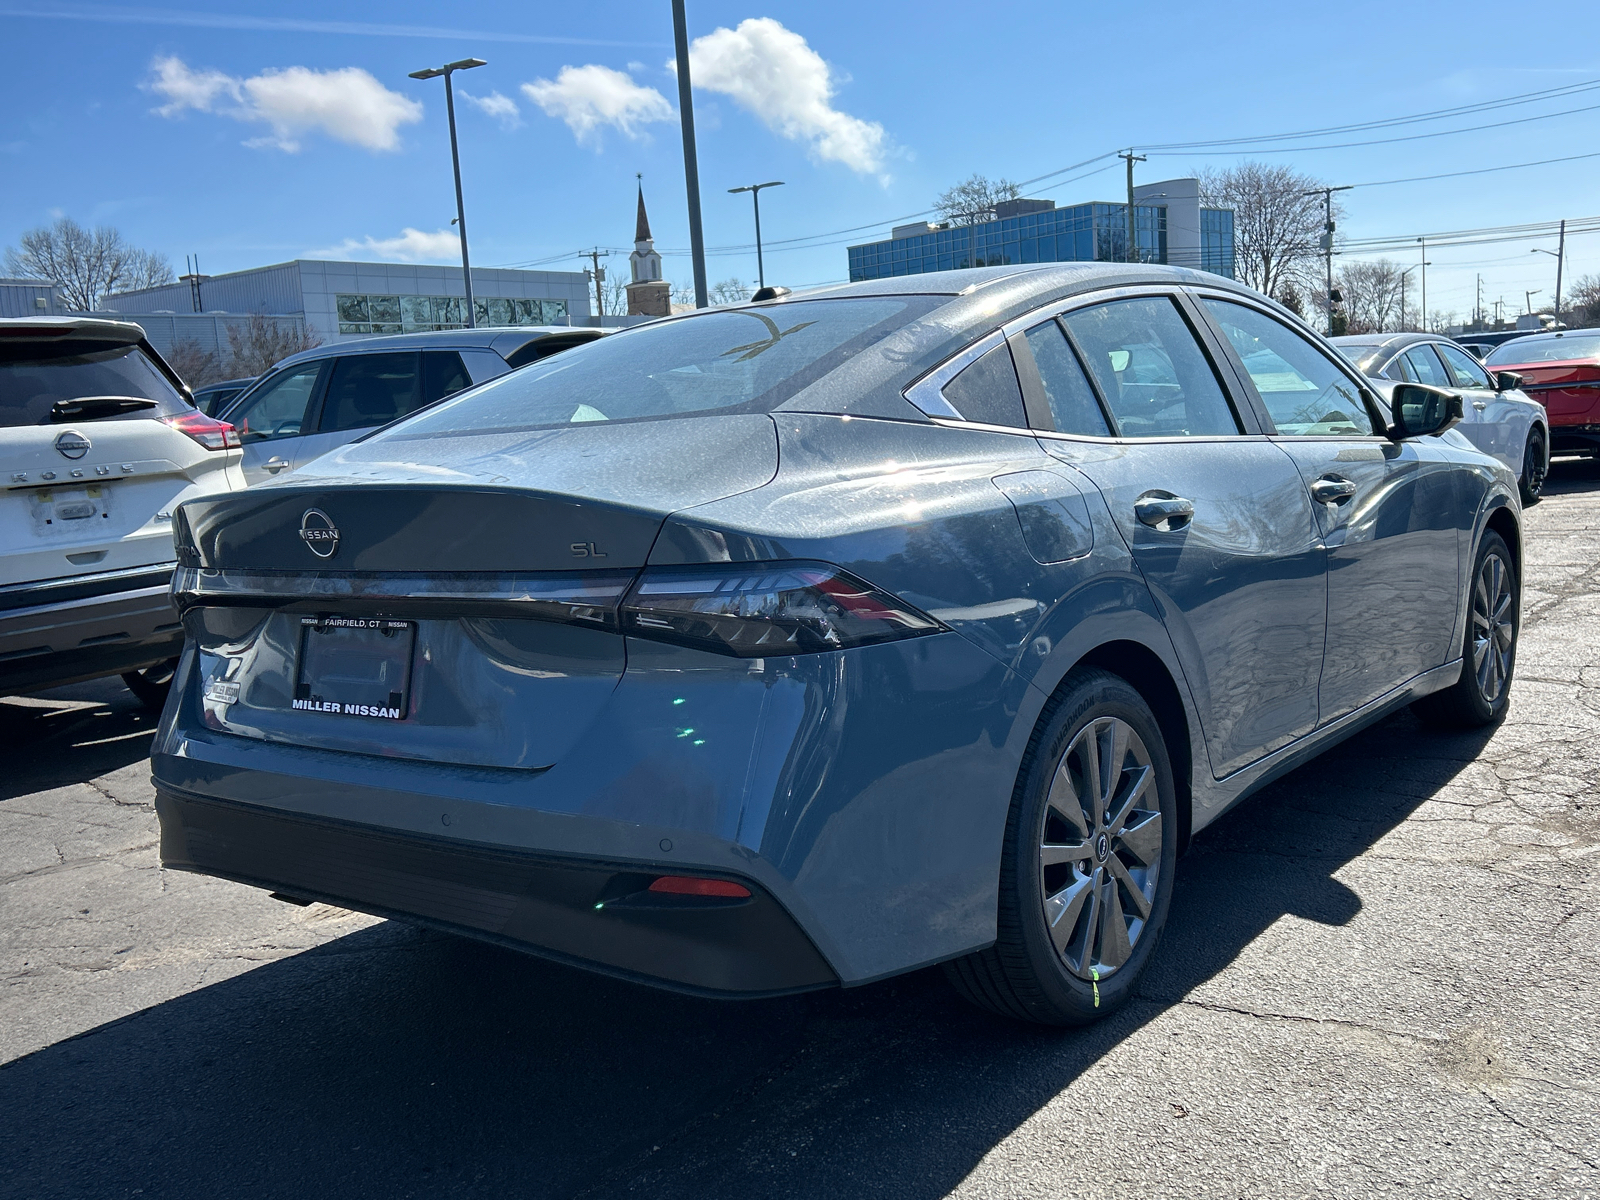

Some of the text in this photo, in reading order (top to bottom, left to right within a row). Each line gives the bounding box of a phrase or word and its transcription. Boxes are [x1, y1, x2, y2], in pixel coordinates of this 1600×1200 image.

[11, 463, 135, 482] ROGUE
[299, 530, 338, 539] NISSAN
[570, 542, 607, 558] SL
[325, 619, 380, 628] FAIRFIELD, CT
[292, 699, 400, 718] MILLER NISSAN
